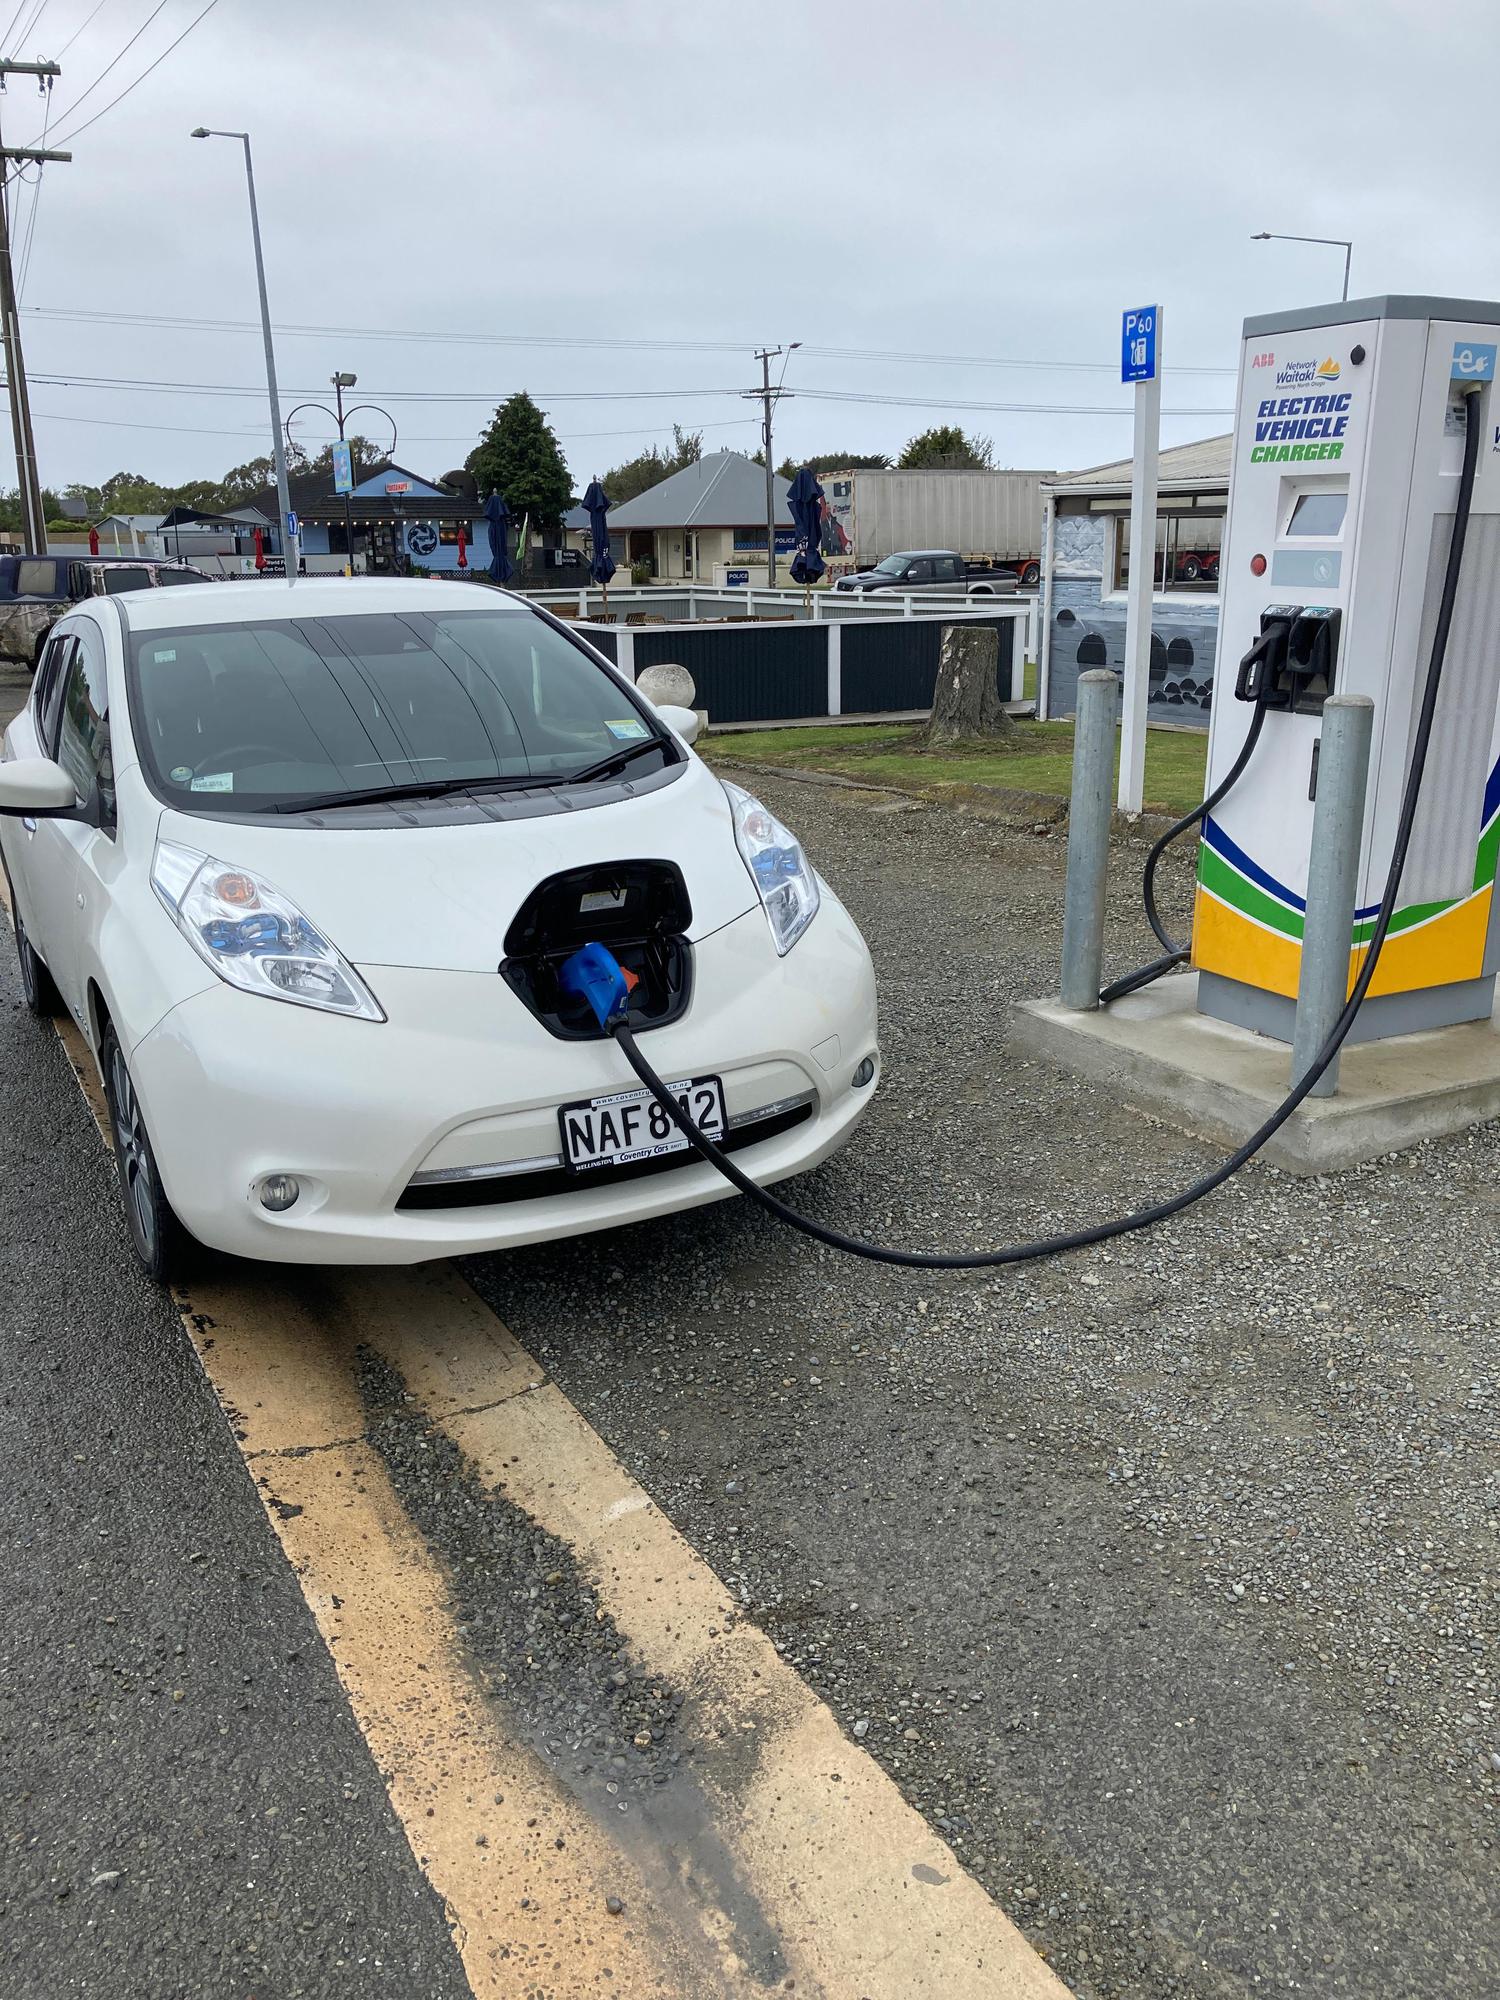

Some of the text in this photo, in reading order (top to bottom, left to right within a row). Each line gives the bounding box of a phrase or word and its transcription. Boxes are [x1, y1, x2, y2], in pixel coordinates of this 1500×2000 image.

[1252, 353, 1275, 368] ABB
[1286, 360, 1318, 371] Network
[1276, 369, 1316, 384] Waitaki
[1257, 393, 1352, 418] ELECTRIC
[1255, 416, 1350, 442] VEHICLE
[1250, 442, 1344, 463] CHARGER
[575, 1158, 613, 1171] WELLINGTON
[619, 1149, 652, 1162] Coventry
[654, 1144, 669, 1154] Cars
